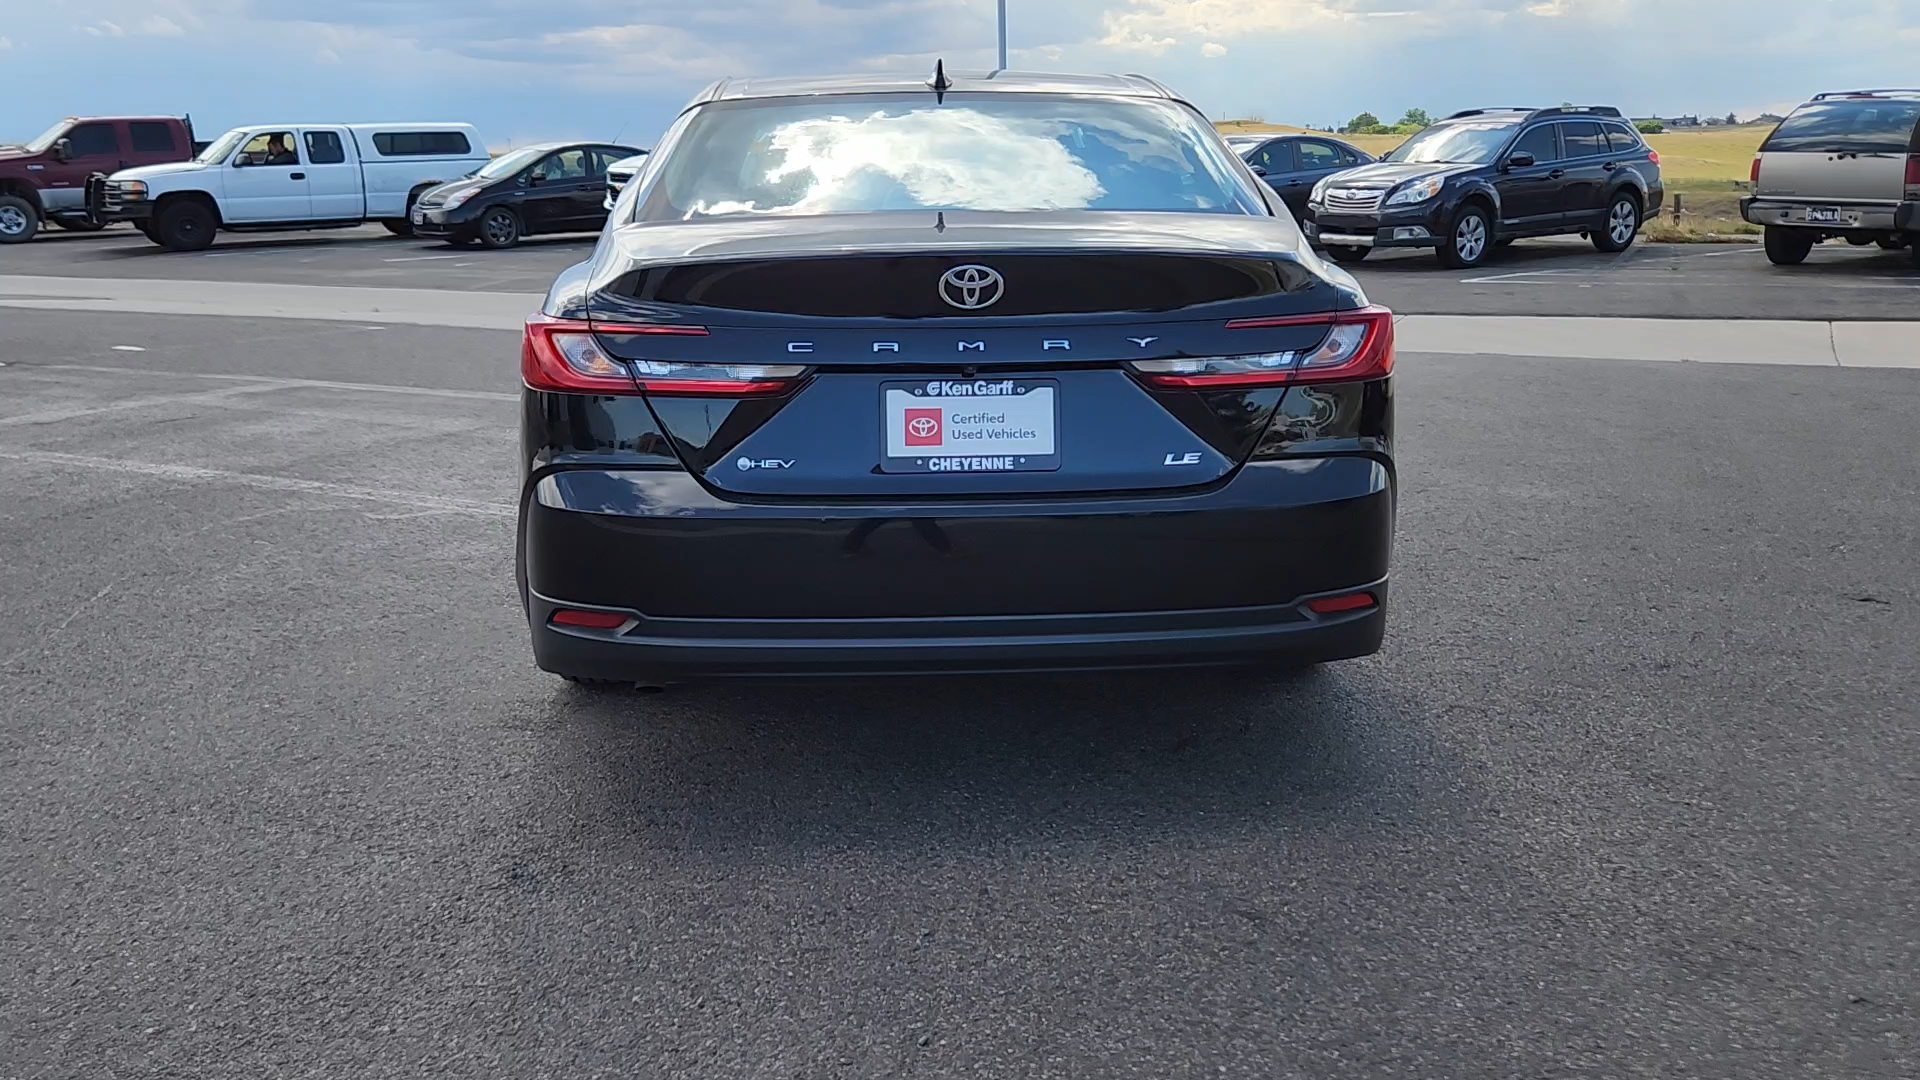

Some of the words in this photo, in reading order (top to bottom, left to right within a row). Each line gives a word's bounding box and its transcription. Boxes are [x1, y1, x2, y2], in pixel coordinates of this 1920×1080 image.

[787, 336, 1159, 352] CAMRY
[941, 382, 971, 396] Ken
[973, 381, 1014, 395] Garff
[951, 412, 1005, 424] Certified
[951, 429, 983, 440] Used
[986, 428, 1037, 440] Vehicles
[751, 459, 797, 469] HEV
[928, 457, 1014, 471] CHEYENNE
[1163, 452, 1202, 466] LE
